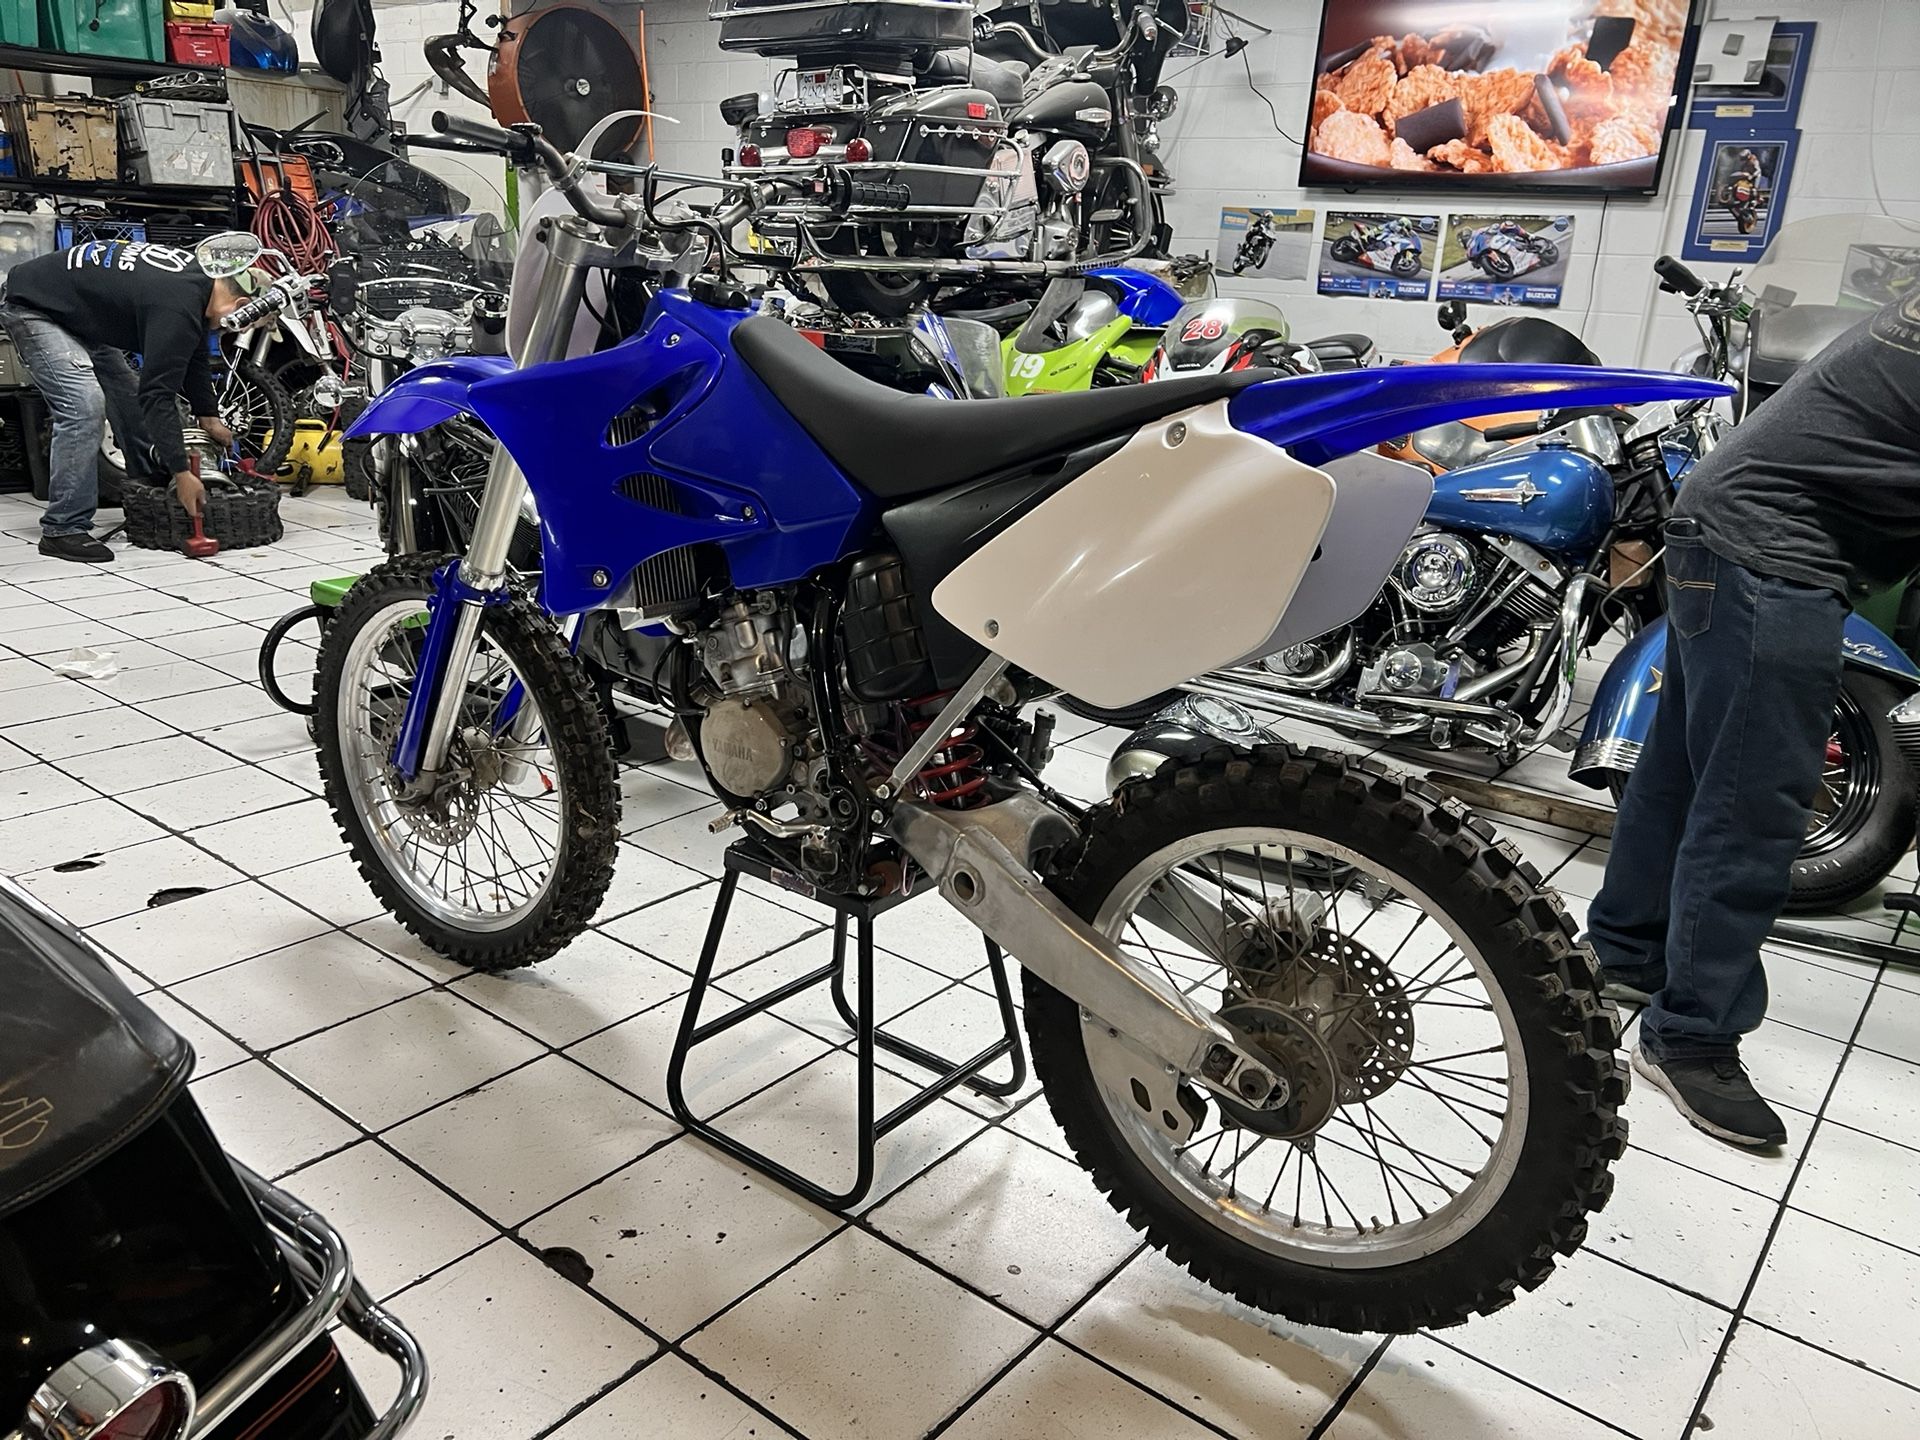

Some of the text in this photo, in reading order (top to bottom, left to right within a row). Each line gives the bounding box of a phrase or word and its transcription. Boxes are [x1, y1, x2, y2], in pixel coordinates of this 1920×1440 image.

[1181, 319, 1223, 342] 28
[1010, 354, 1045, 378] 19
[712, 738, 753, 761] YAMAHA
